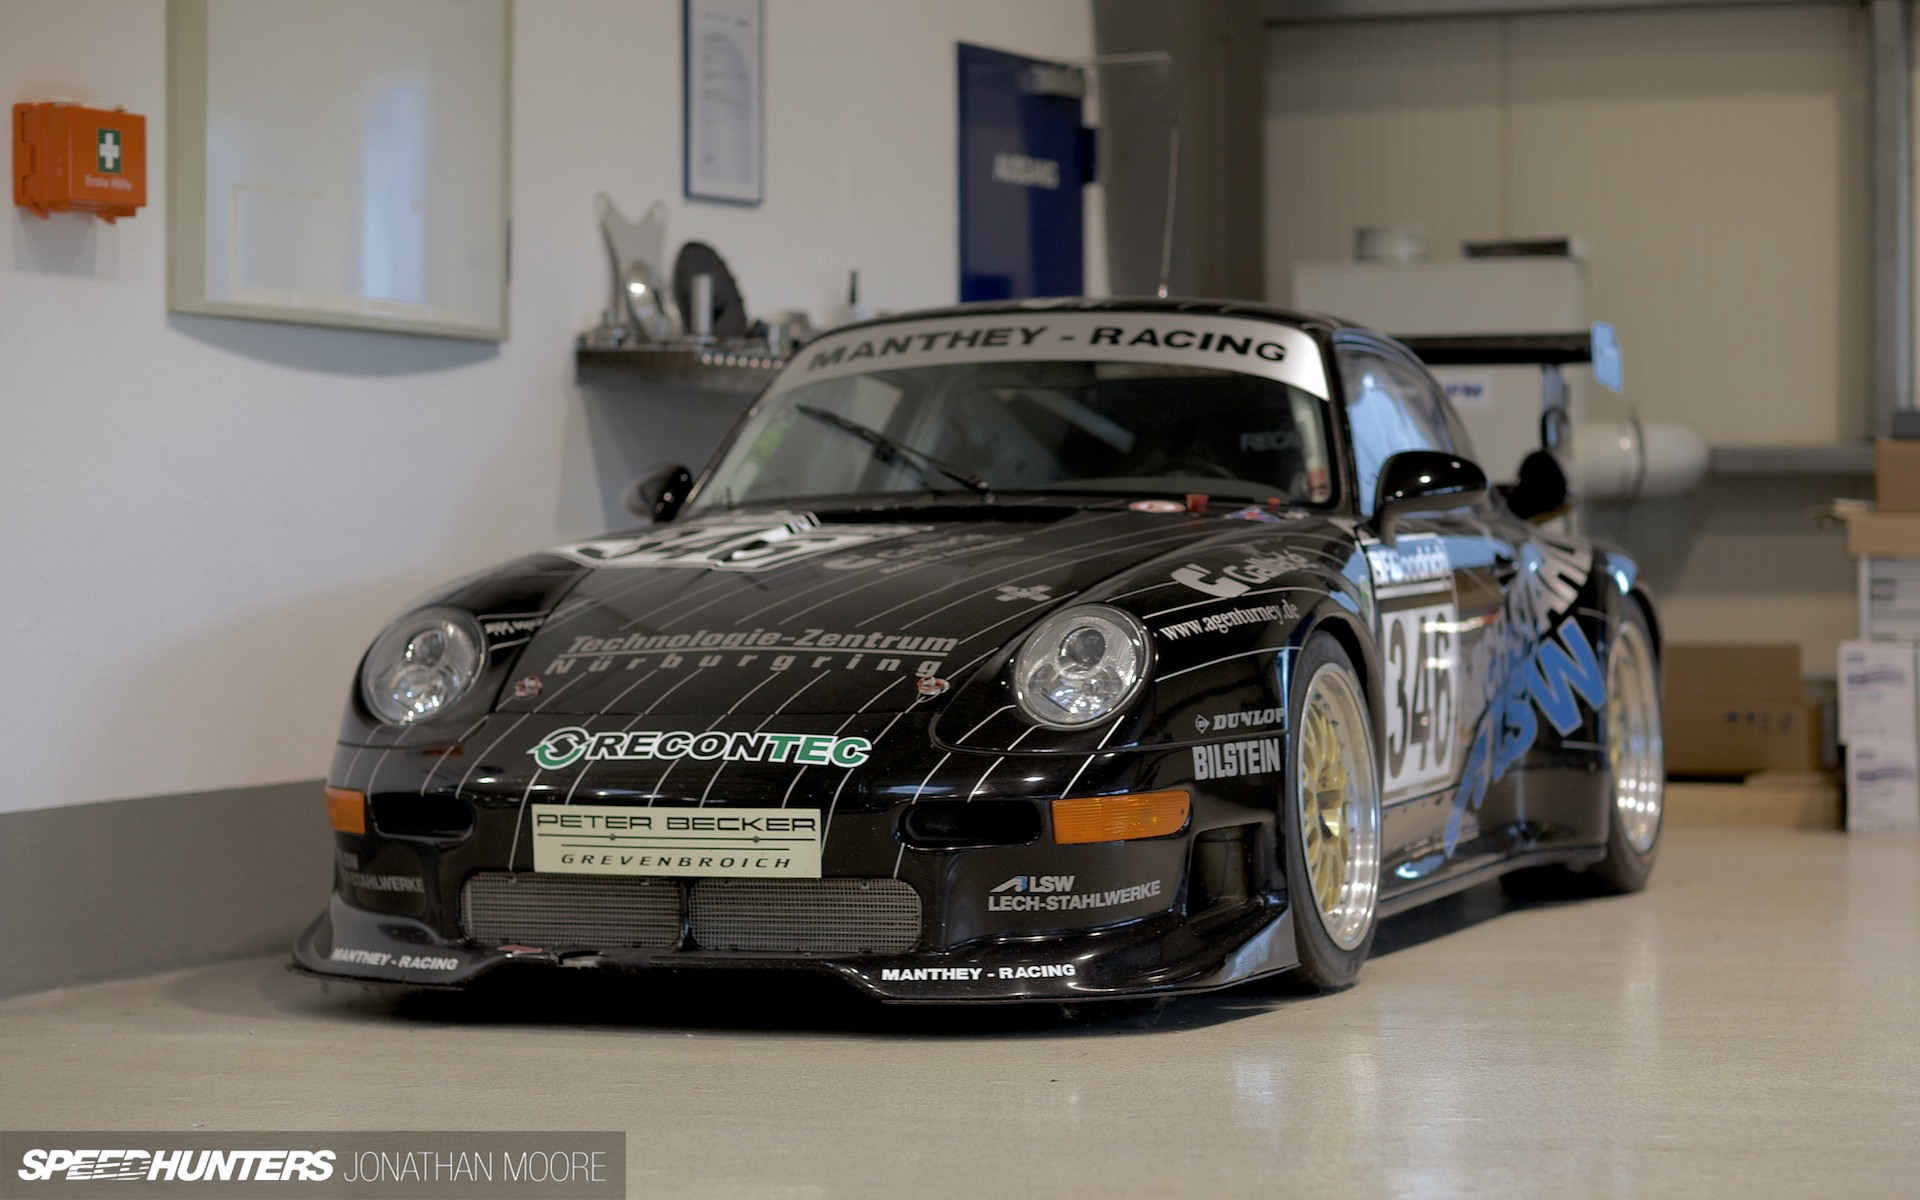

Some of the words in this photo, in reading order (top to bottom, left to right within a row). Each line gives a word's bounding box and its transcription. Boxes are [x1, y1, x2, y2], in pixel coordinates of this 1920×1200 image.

[808, 326, 1046, 371] MANTHEY
[1091, 327, 1288, 362] RACING
[1160, 600, 1301, 642] www.agenturney.de
[567, 629, 959, 654] Technologie-Zentrum
[545, 653, 943, 678] Nürburgring
[1212, 708, 1285, 732] DUNLOP
[585, 730, 873, 768] RECONTEC
[1192, 738, 1281, 781] BILSTEIN
[537, 814, 652, 830] PETER
[667, 816, 816, 832] BECKER
[561, 854, 792, 868] GREVENBROICH
[988, 880, 1161, 912] LECH-STAHLWERKE
[1029, 875, 1075, 893] LSW
[331, 947, 391, 966] MANTHEY
[399, 955, 459, 971] RACING
[881, 968, 983, 981] MANTHEY
[999, 963, 1076, 980] RACING
